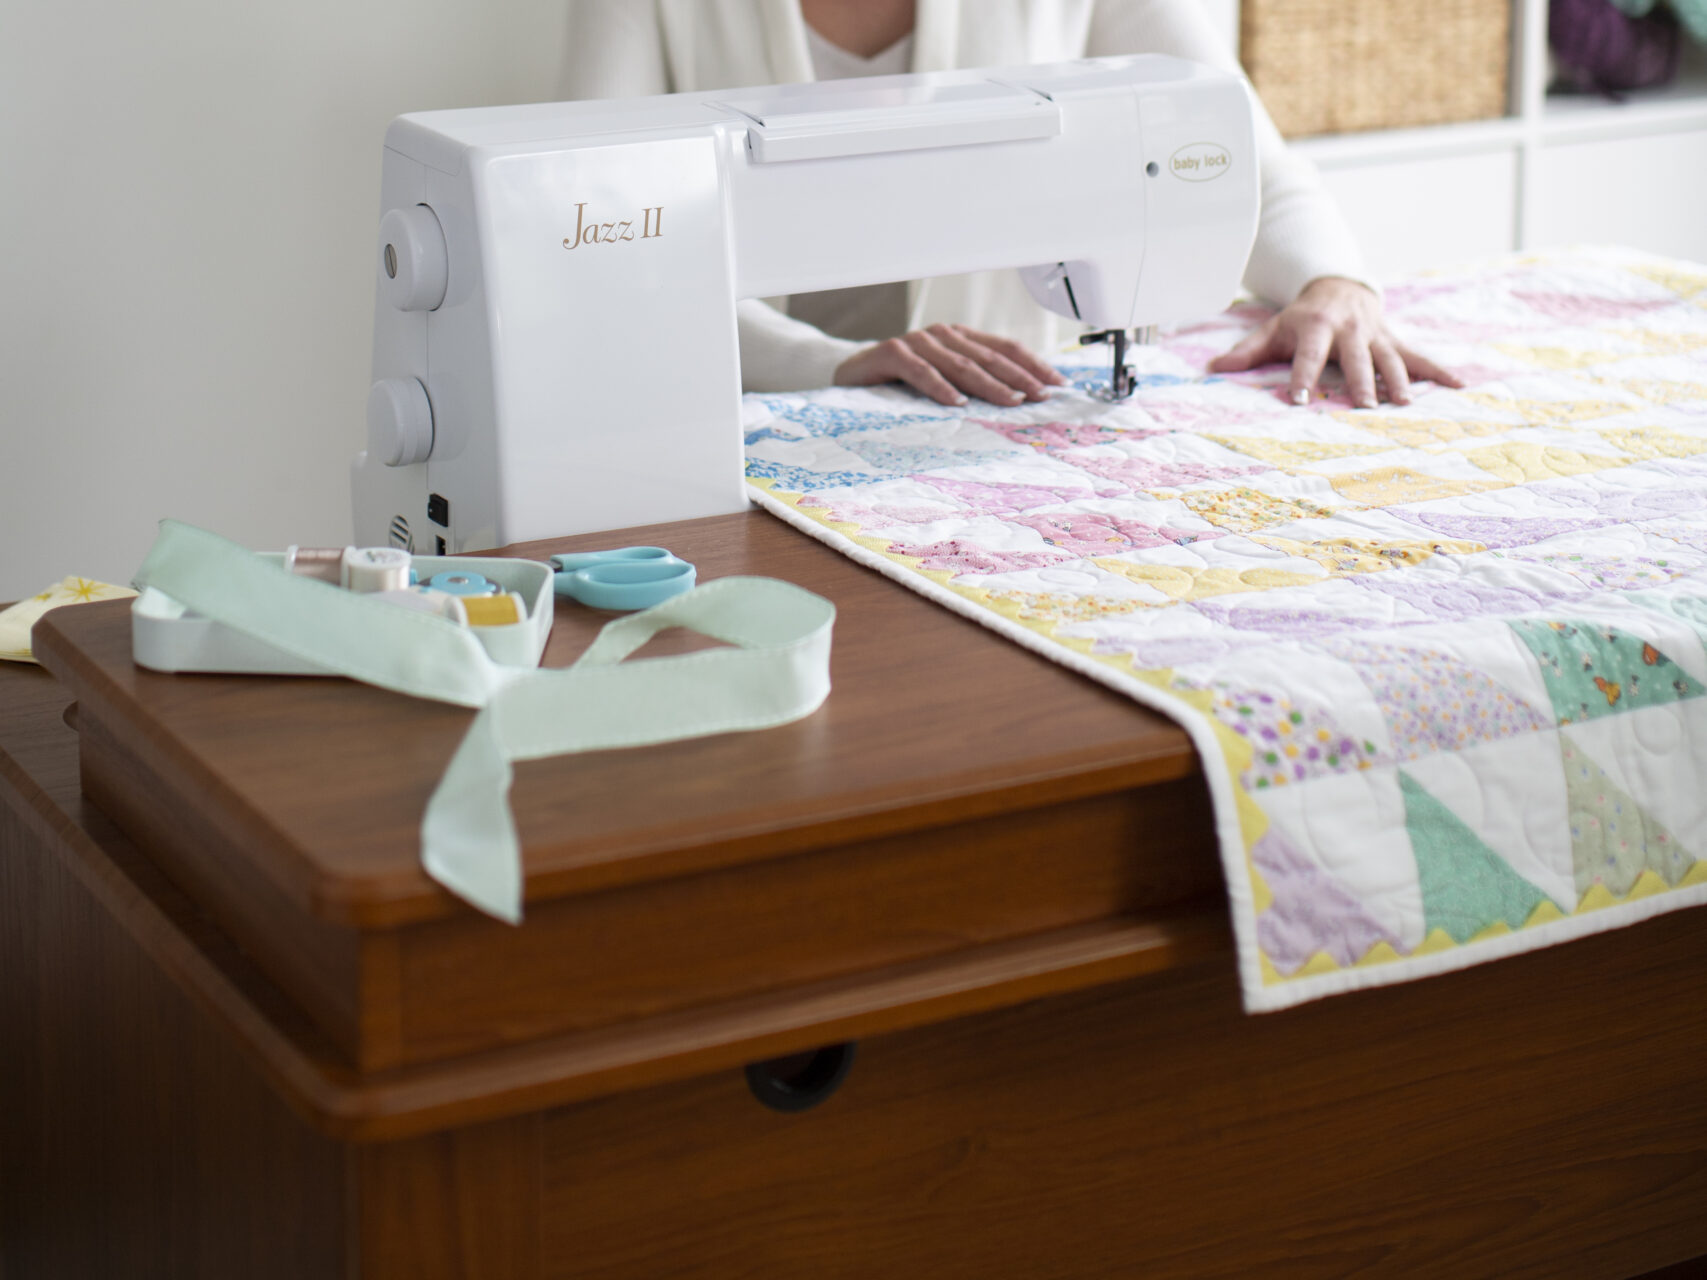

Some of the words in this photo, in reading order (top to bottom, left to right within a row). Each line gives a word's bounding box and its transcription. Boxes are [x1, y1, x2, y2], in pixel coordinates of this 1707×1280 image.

[1174, 156, 1200, 171] baby
[1204, 154, 1227, 167] lock
[563, 203, 634, 249] Jazz
[640, 206, 664, 238] II
